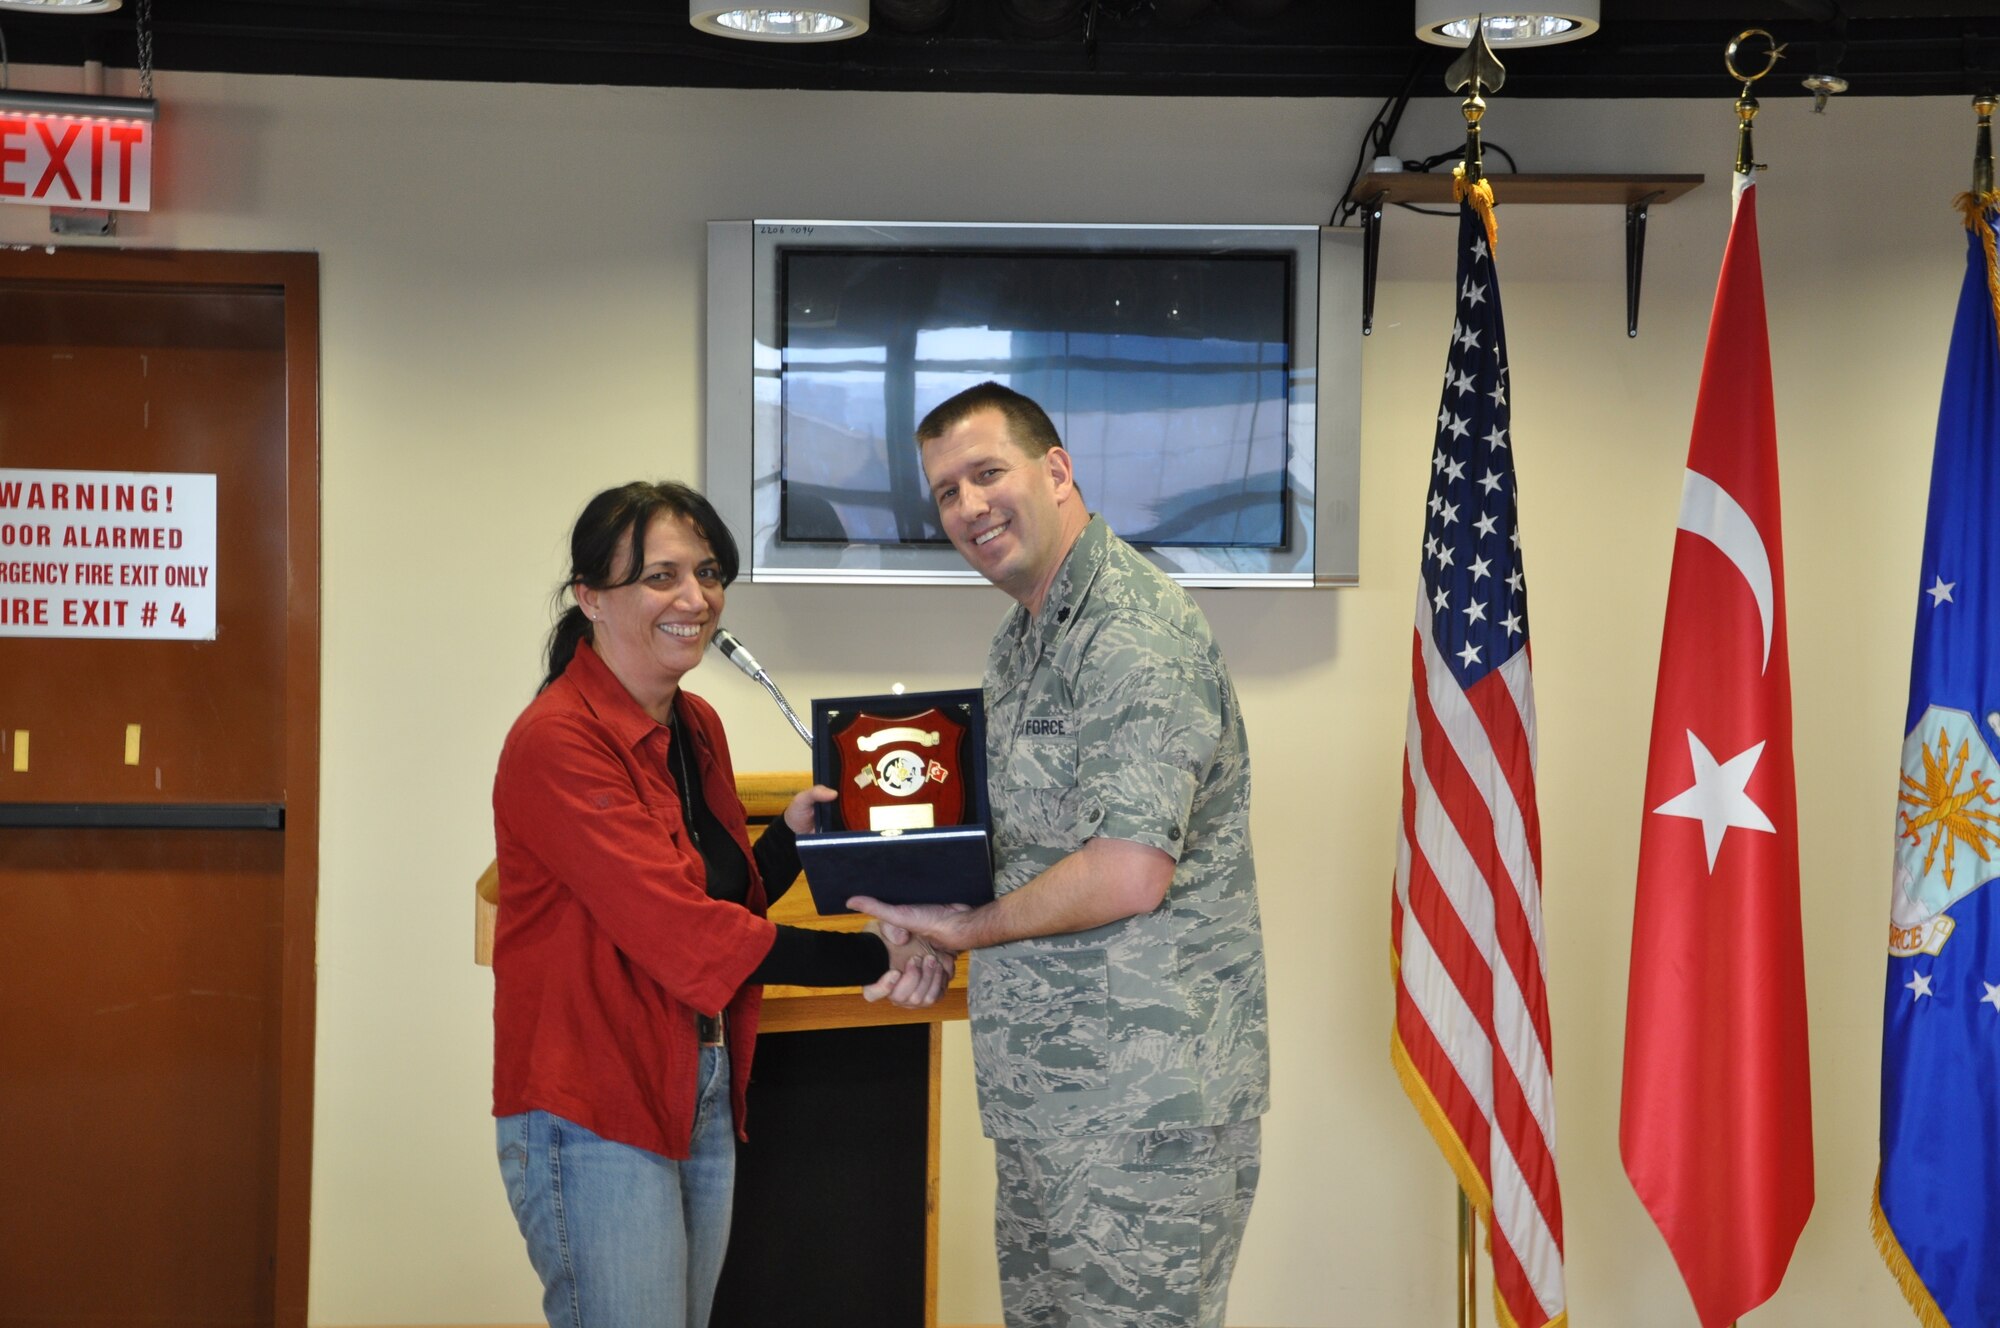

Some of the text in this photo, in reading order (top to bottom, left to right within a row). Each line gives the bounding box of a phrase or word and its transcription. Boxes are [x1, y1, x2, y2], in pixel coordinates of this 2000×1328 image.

[0, 120, 143, 203] EXIT
[0, 482, 173, 513] WARNING!
[2, 524, 183, 549] OOR ALARMED
[0, 562, 209, 587] RGENCY FIRE EXIT ONLY
[1, 598, 187, 628] IRE EXIT # 4
[1025, 719, 1066, 735] FORCE
